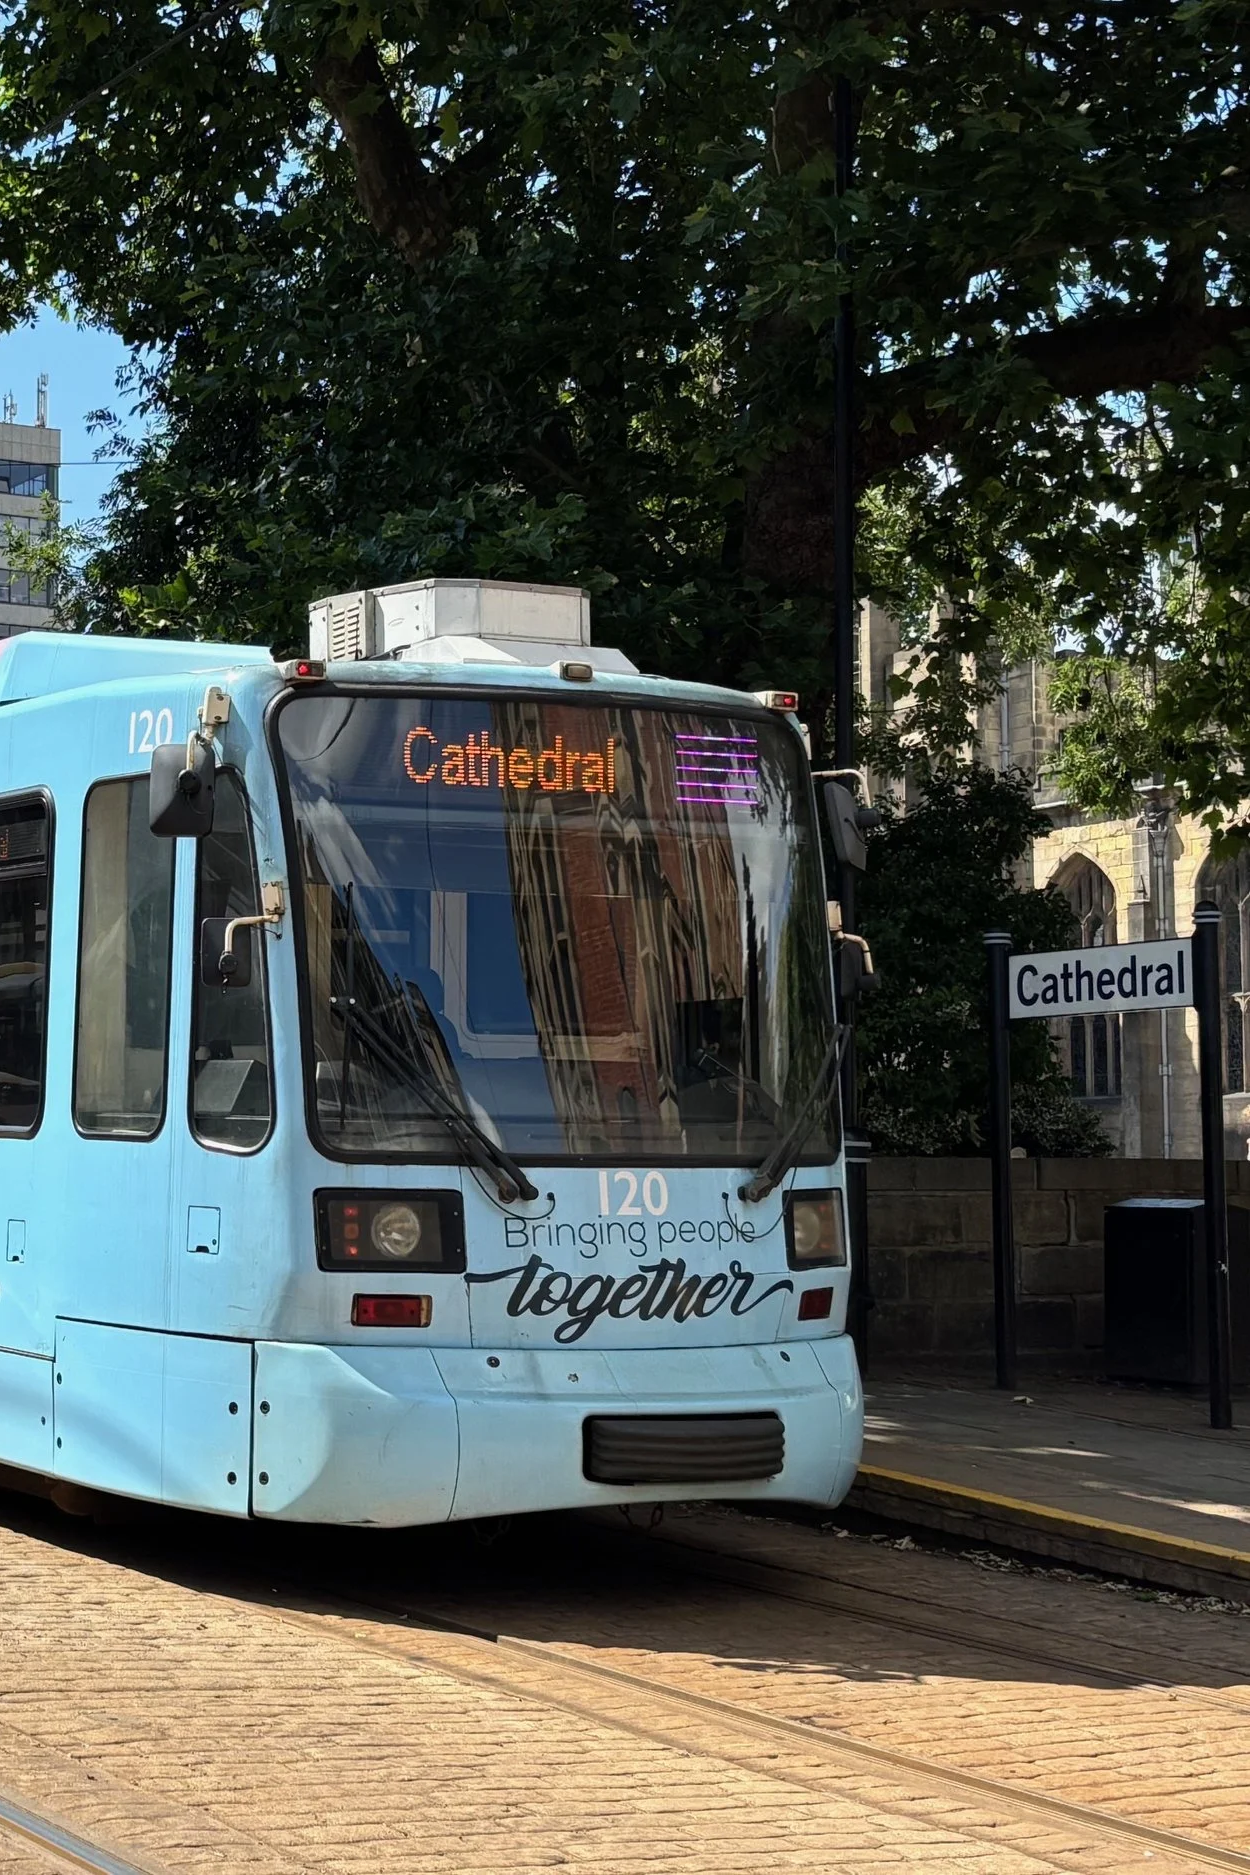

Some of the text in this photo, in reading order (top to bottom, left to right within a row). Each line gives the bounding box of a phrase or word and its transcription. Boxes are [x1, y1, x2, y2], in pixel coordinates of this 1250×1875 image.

[128, 708, 173, 754] 120
[403, 726, 615, 794] Cathedral
[1016, 950, 1185, 1007] Cathedral
[599, 1170, 669, 1217] 120
[504, 1213, 756, 1259] Bringing people
[463, 1253, 794, 1344] together
